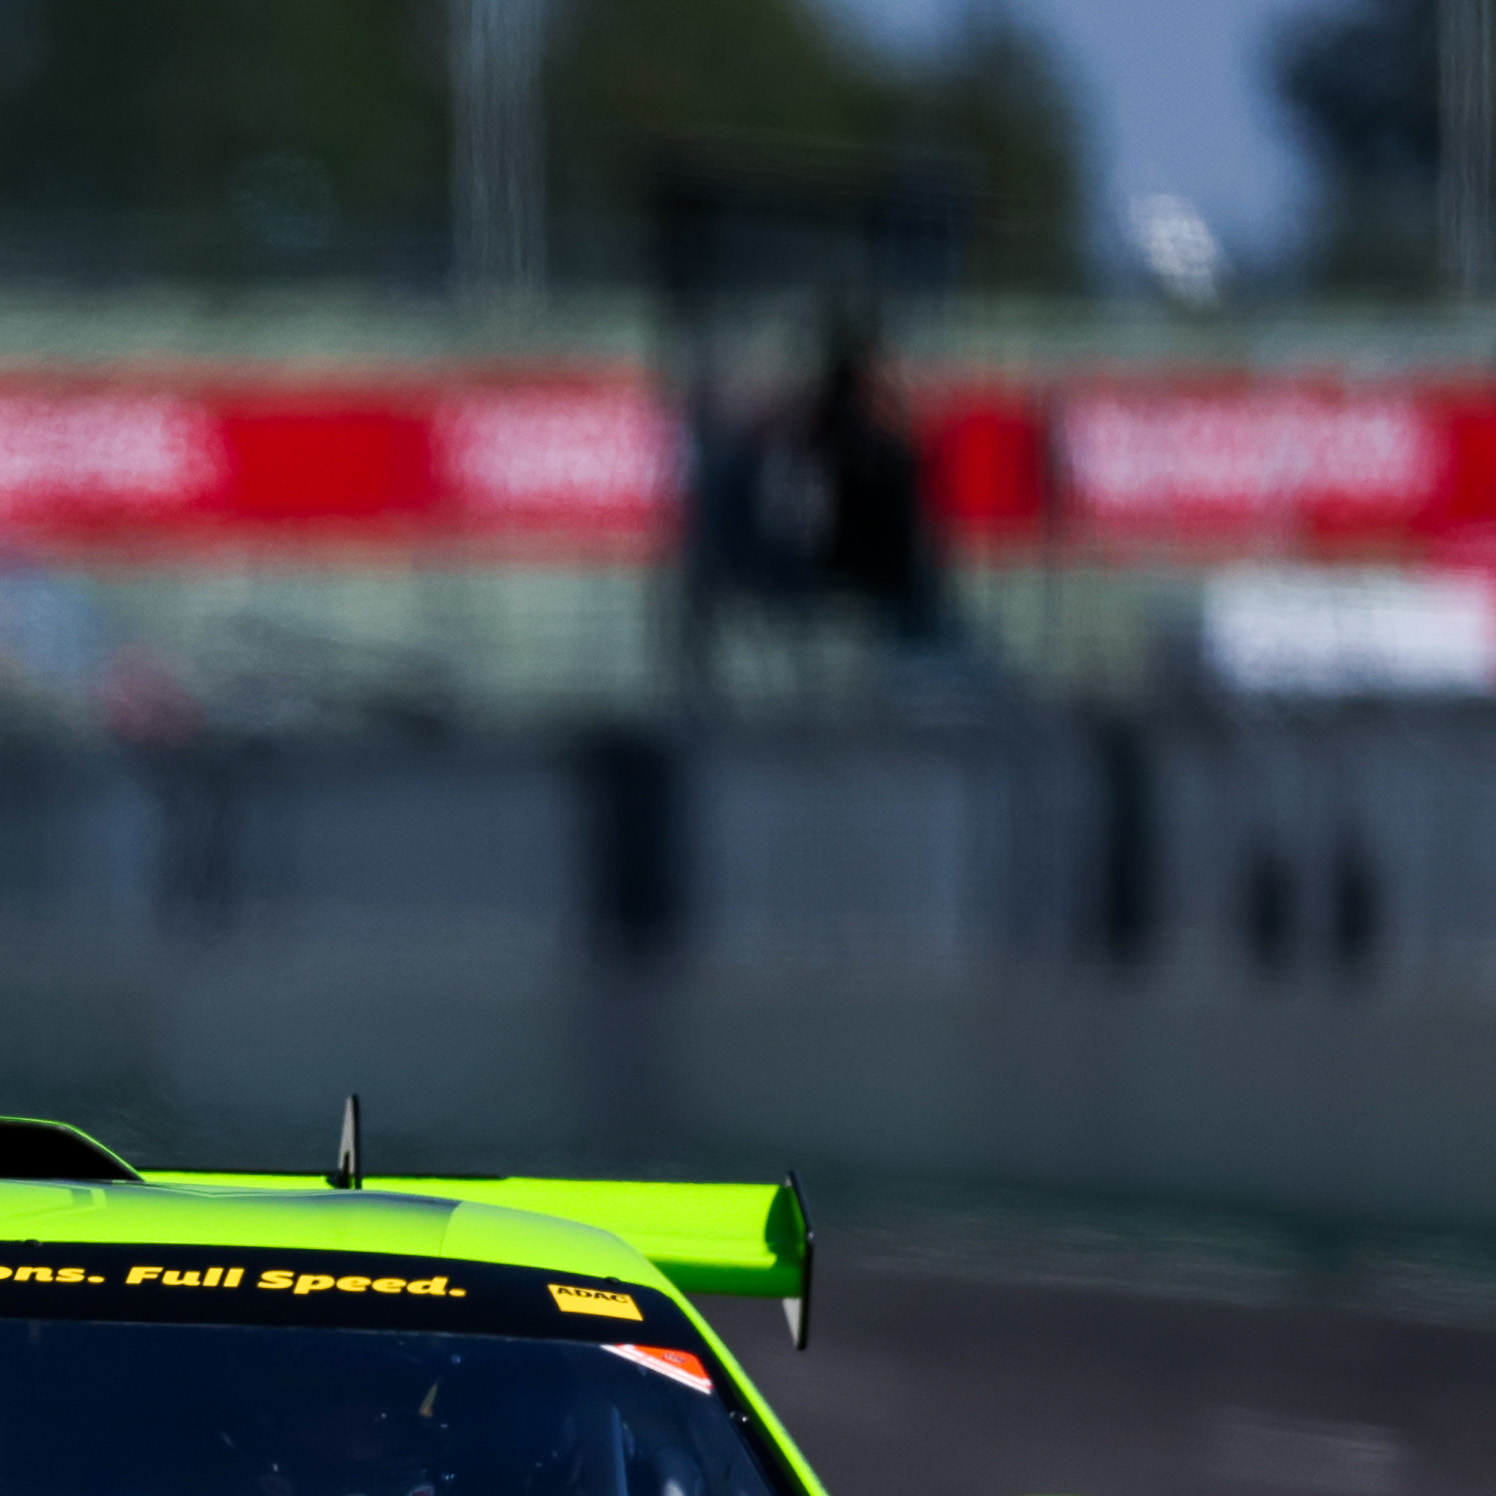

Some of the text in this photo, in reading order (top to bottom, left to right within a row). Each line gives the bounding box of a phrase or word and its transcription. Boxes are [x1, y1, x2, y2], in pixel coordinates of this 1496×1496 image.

[126, 1266, 244, 1288] Full
[257, 1270, 467, 1297] Speed.
[556, 1286, 629, 1304] ADAC
